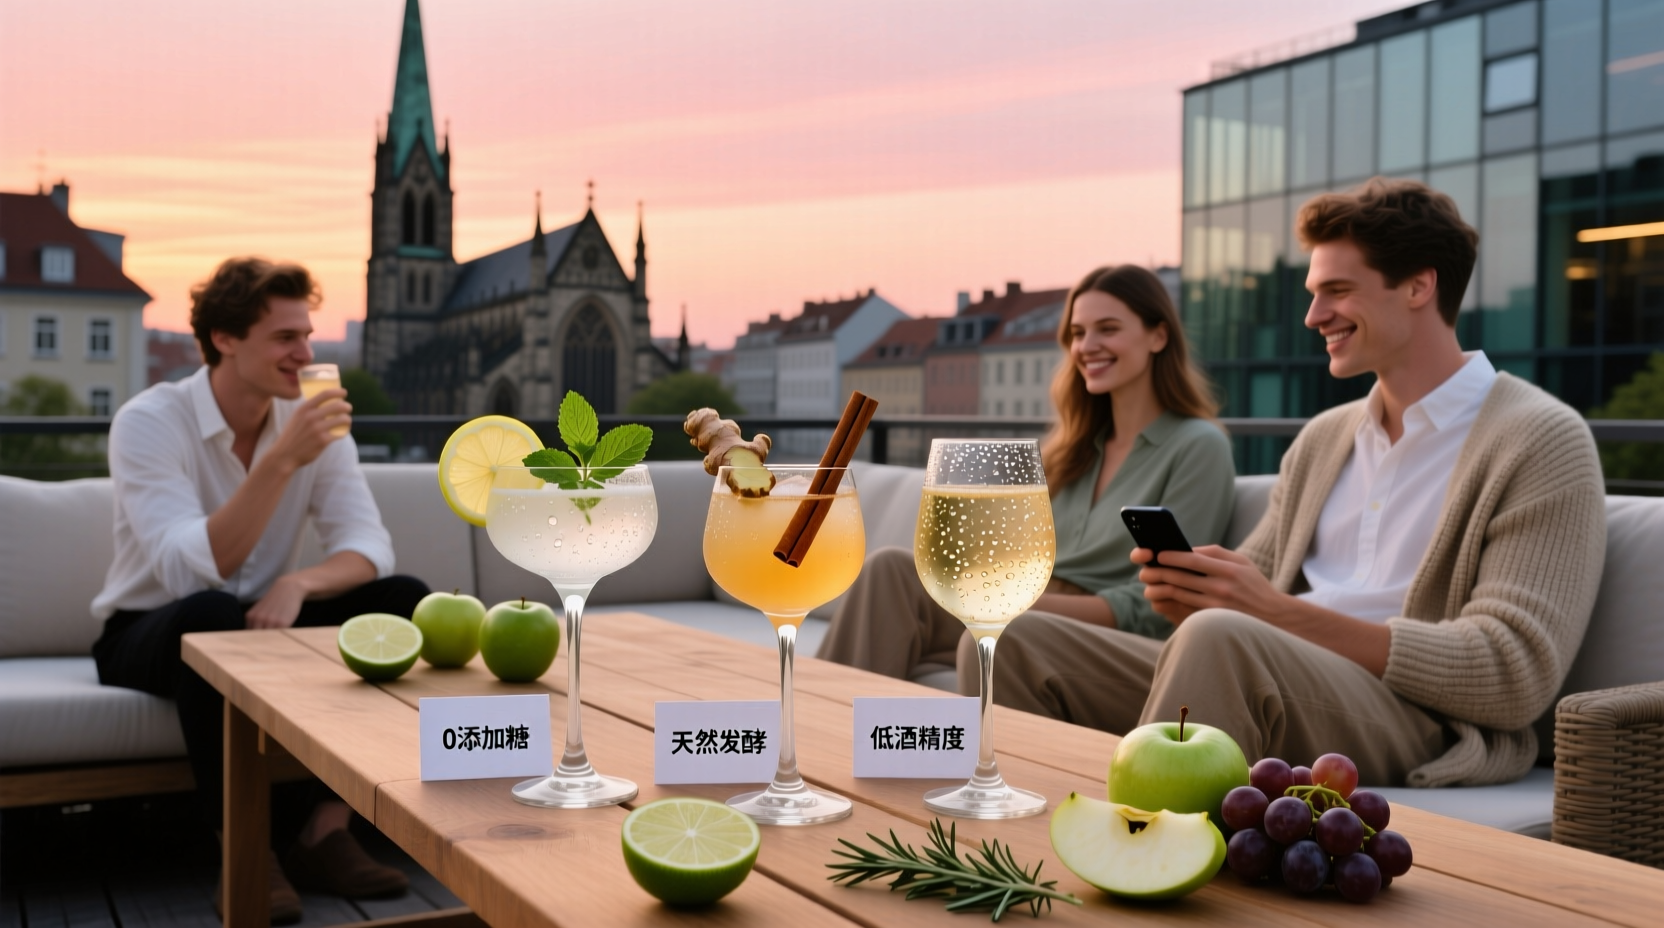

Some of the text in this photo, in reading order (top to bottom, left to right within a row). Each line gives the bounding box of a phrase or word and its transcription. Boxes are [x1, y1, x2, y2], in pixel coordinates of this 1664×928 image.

[442, 723, 530, 752] 0添加糖
[671, 727, 768, 755] 天然发酵
[870, 724, 965, 751] 低酒精度
